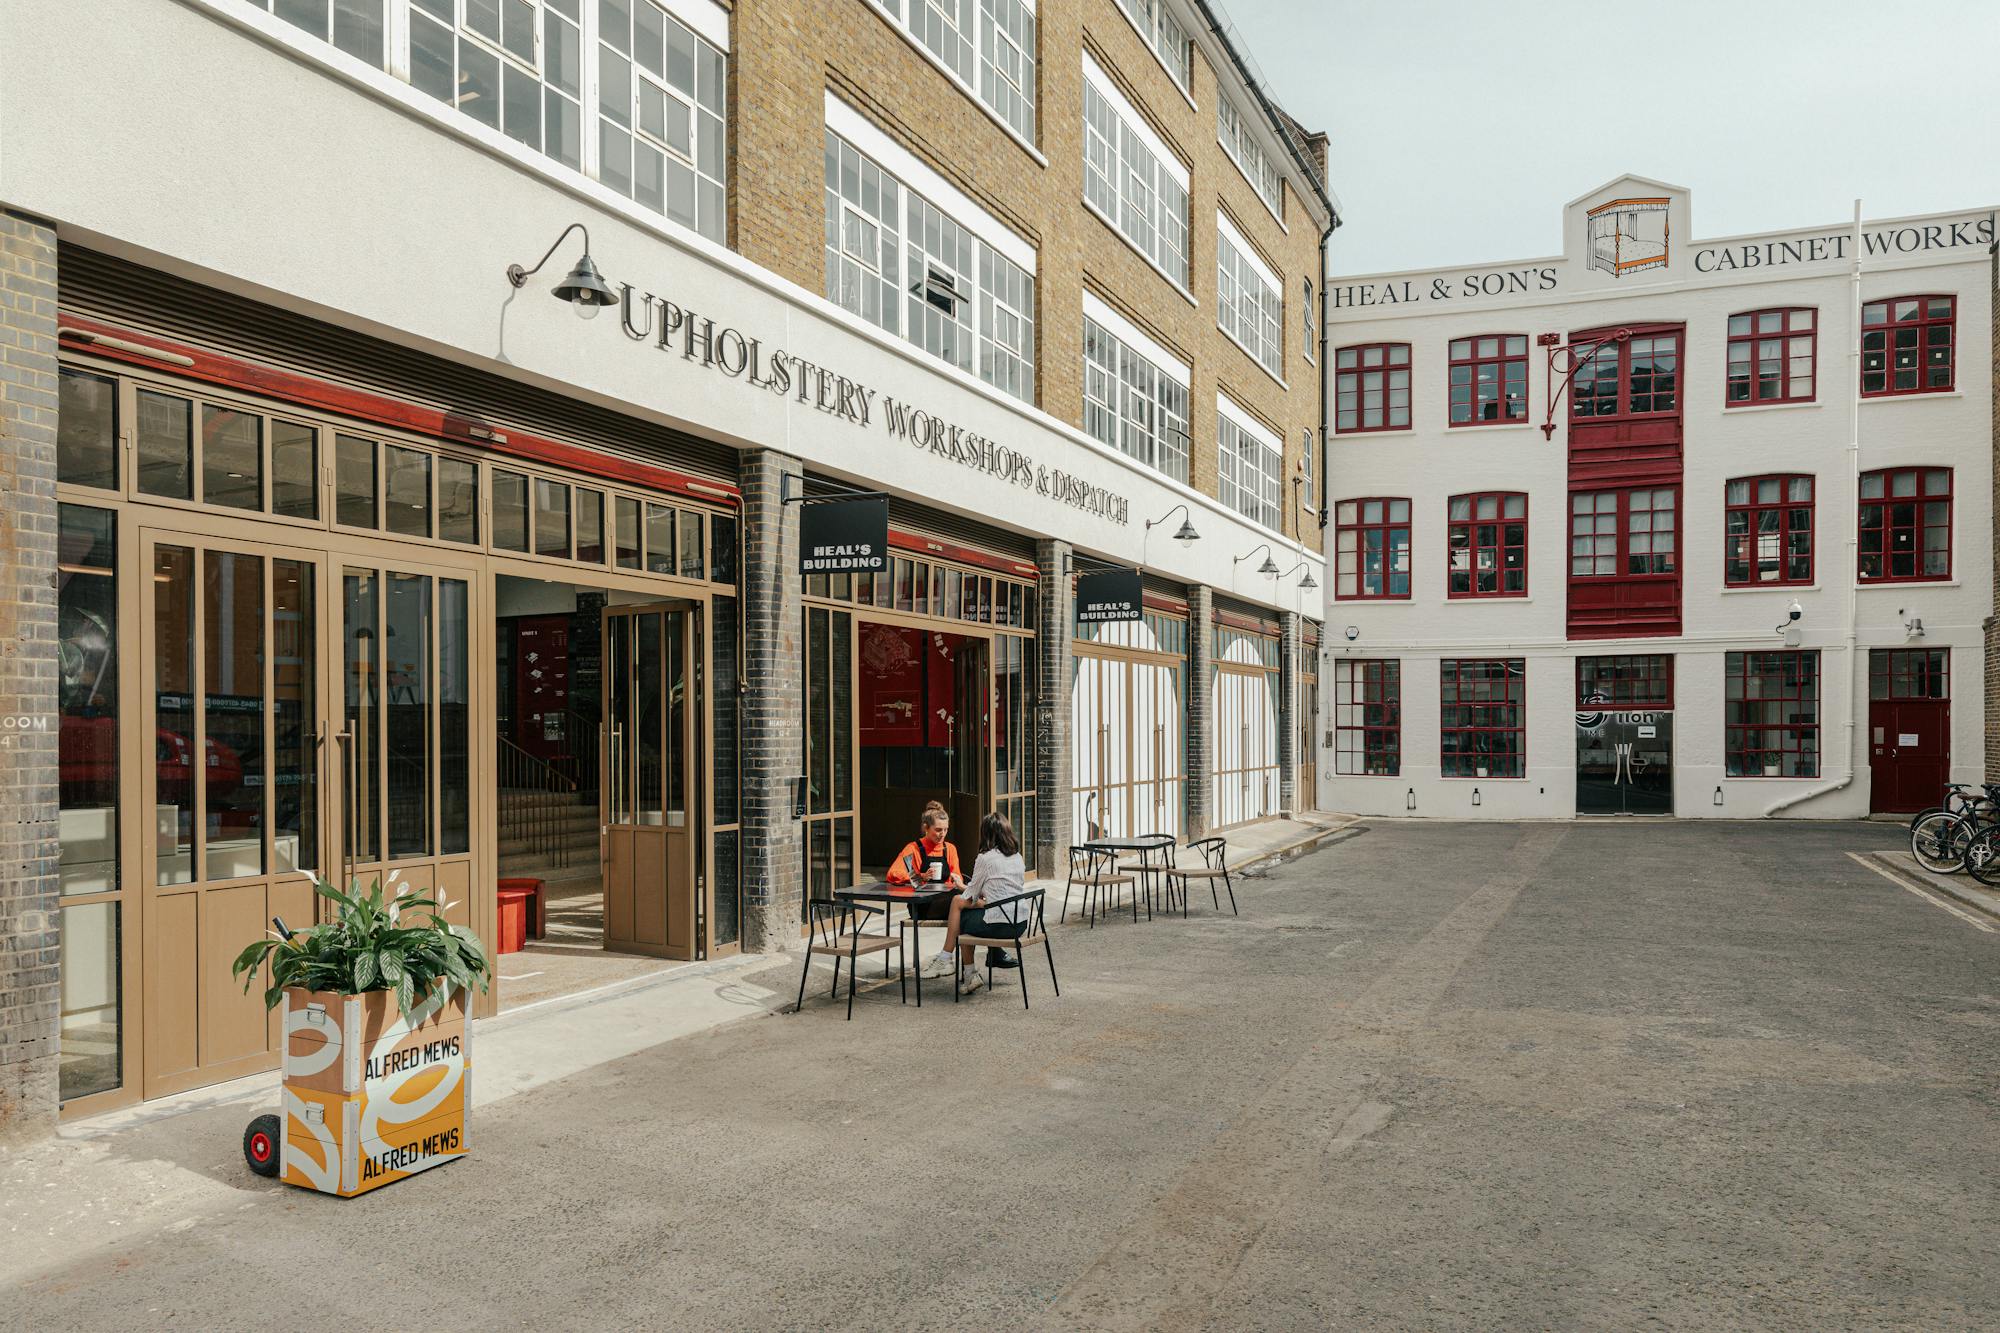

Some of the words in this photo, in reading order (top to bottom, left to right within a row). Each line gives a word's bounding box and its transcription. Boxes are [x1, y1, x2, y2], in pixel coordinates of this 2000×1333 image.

[1695, 235, 1851, 273] CABINET
[1863, 219, 1994, 256] WORKS
[1333, 281, 1419, 308] HEAL
[1430, 278, 1453, 300] &
[1463, 268, 1558, 297] SON'S
[620, 281, 877, 424] UPHOLSTERY
[885, 396, 1033, 487] WORKSHOPS
[1037, 464, 1050, 495] &
[1053, 469, 1128, 525] DISPATCH
[803, 557, 882, 569] BUILDING
[814, 544, 872, 556] HEAL'S
[1080, 610, 1139, 620] BUILDING
[1088, 602, 1131, 611] HEAL'S
[0, 716, 46, 730] OOM
[364, 1046, 419, 1081] ALFRED
[423, 1035, 460, 1064] MEWS
[363, 1142, 418, 1181] ALFRED
[422, 1127, 459, 1159] MEWS
